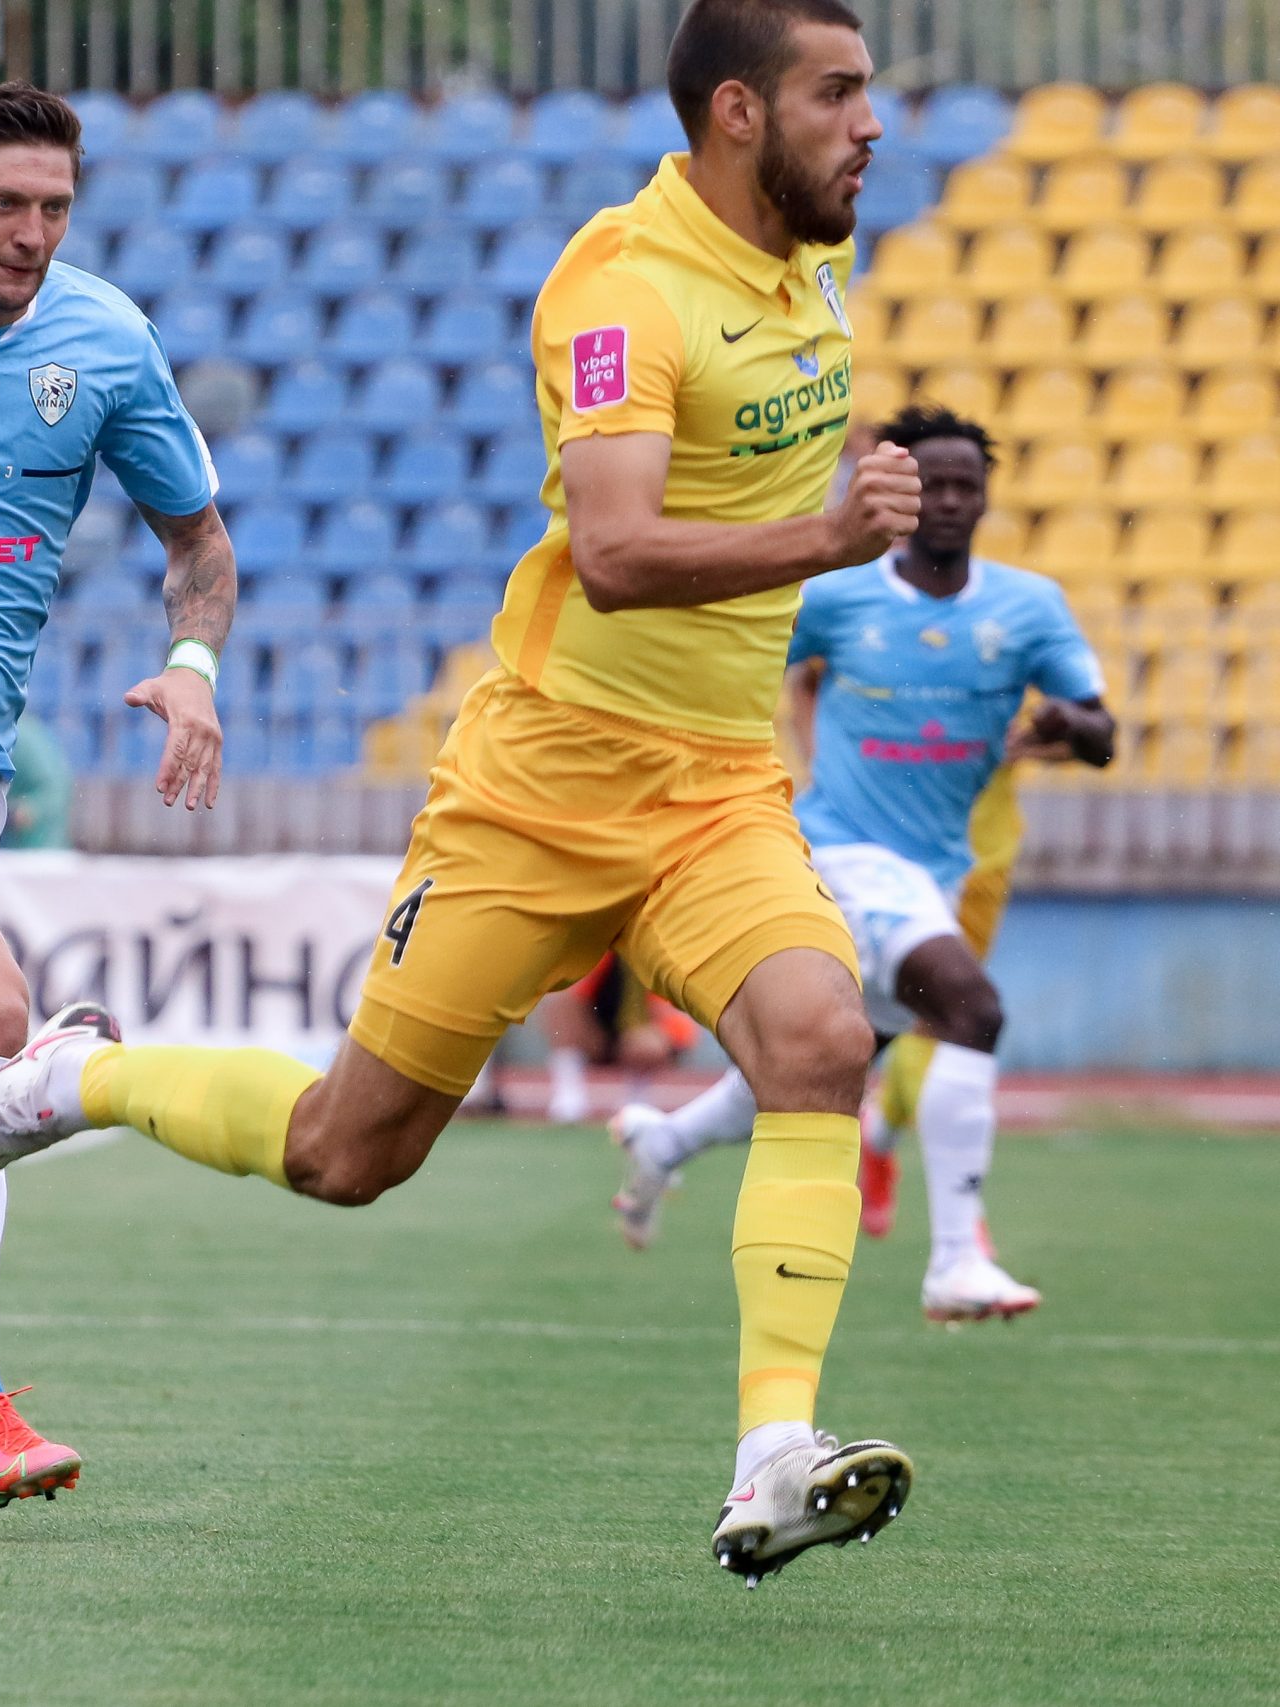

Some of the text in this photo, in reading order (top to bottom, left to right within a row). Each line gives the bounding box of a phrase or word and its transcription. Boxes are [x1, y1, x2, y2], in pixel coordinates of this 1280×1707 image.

[581, 351, 617, 373] vbet
[36, 399, 69, 411] MINAJ
[384, 877, 435, 967] 4
